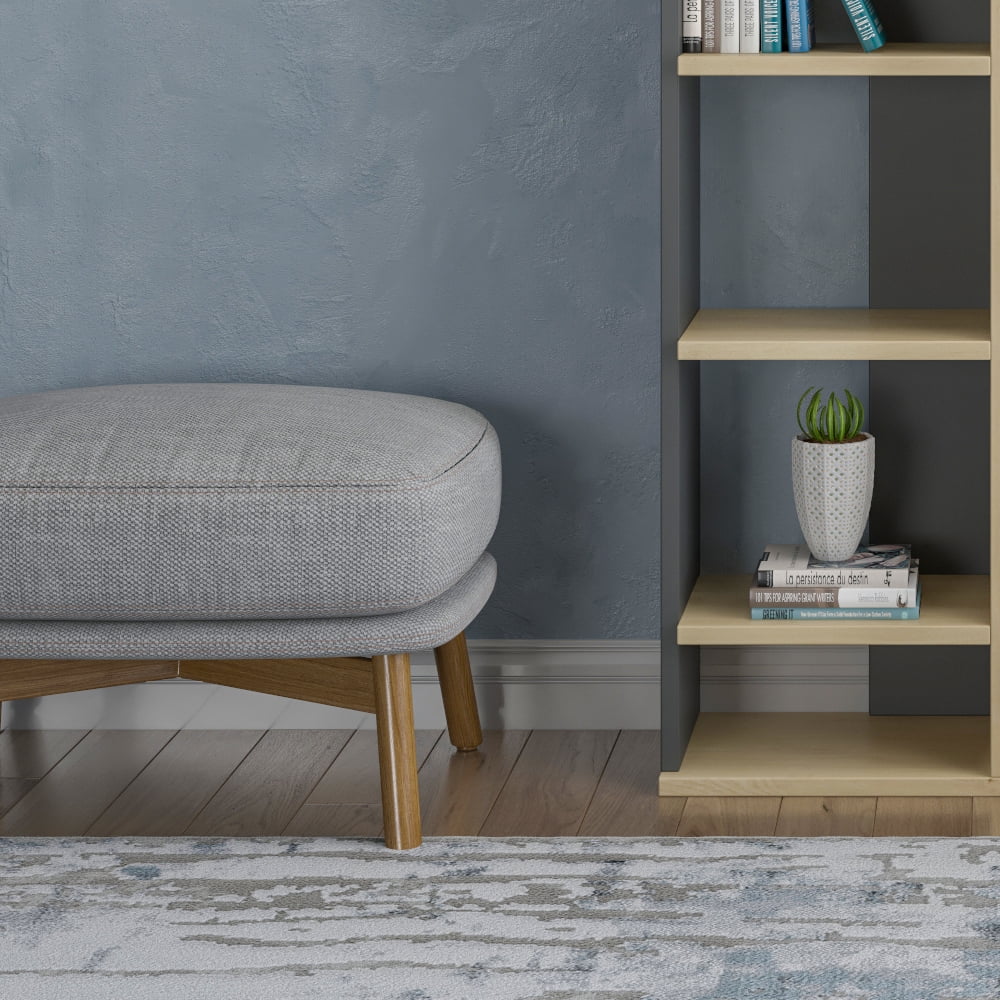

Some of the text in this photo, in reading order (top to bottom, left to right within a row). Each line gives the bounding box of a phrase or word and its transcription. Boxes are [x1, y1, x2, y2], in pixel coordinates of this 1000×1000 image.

[682, 14, 698, 23] La
[725, 8, 734, 21] PAIRS
[745, 8, 754, 21] PAIRS
[725, 23, 734, 37] THREE
[745, 23, 754, 37] THREE
[764, 21, 778, 43] SILENT
[855, 16, 875, 40] SILENT
[786, 570, 868, 587] La persistance du destin
[763, 592, 772, 602] TIPS
[773, 592, 781, 602] FOR
[782, 592, 801, 602] ASPIRING
[802, 592, 816, 602] GRANT
[817, 592, 834, 602] WRITERS
[762, 609, 787, 620] GREENING
[788, 609, 794, 620] IT
